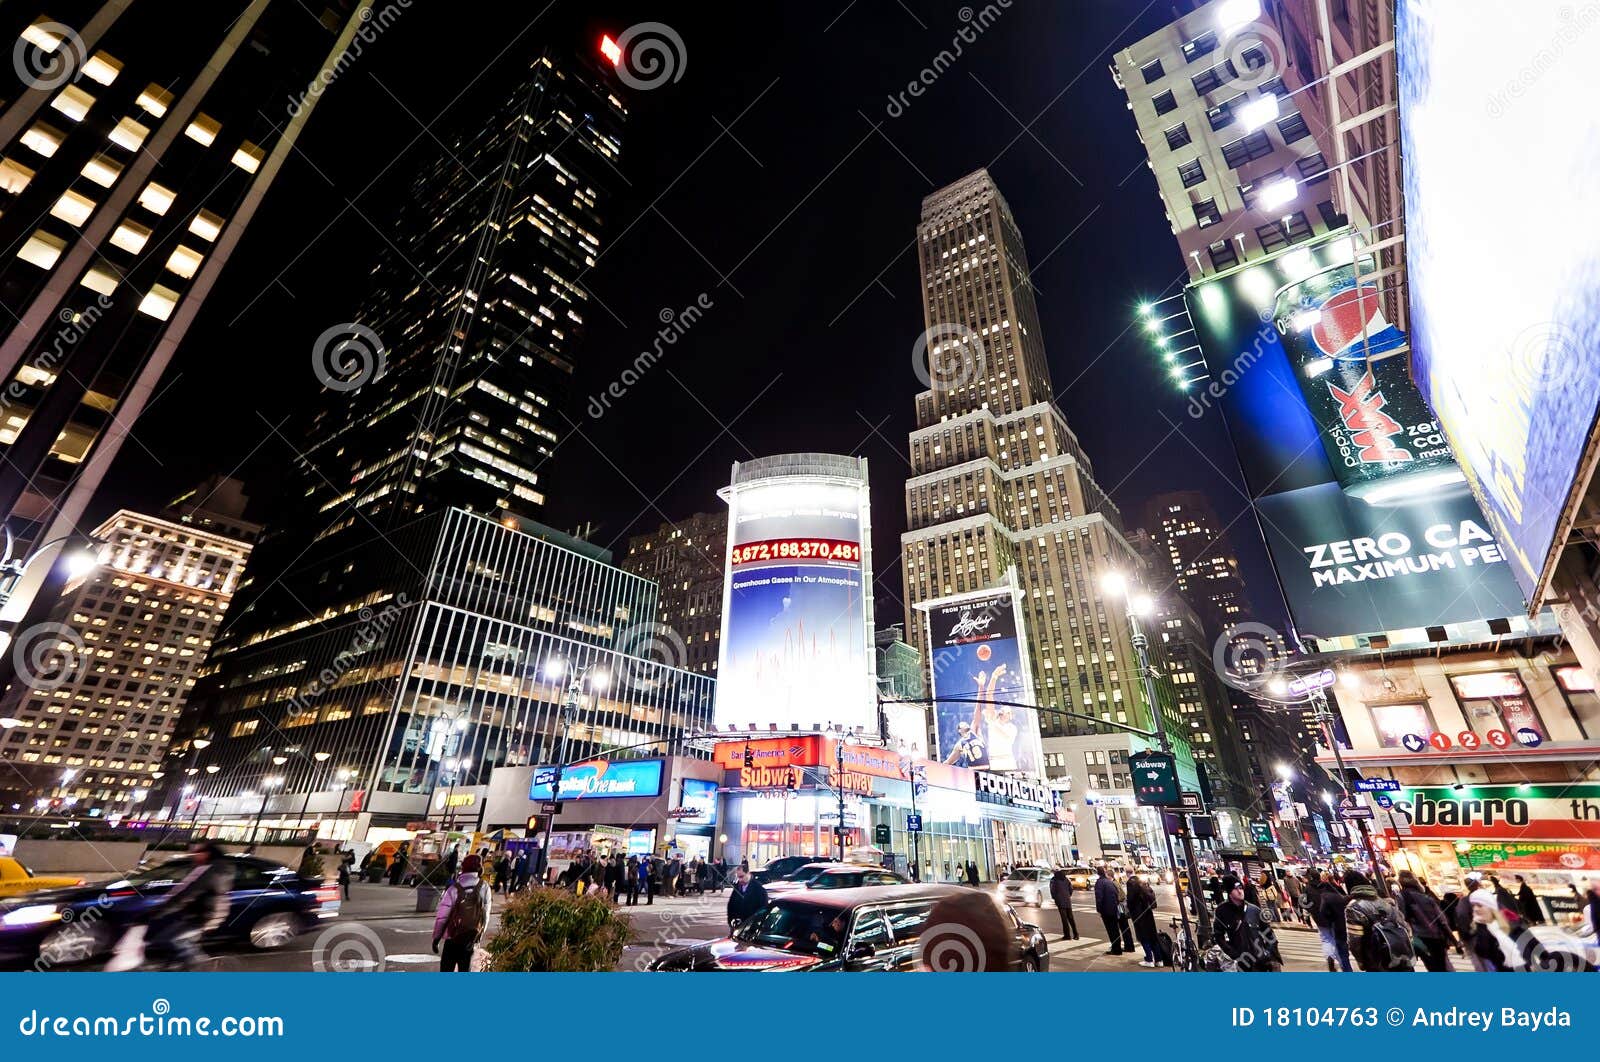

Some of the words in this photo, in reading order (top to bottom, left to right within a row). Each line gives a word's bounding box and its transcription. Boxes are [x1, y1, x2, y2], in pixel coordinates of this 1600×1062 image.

[1329, 424, 1358, 468] pepsi
[1304, 532, 1411, 568] ZERO
[1424, 520, 1494, 548] CA
[1312, 551, 1456, 587] MAXIMUM
[733, 579, 771, 589] Greenhouse
[818, 576, 859, 586] Atmosphere
[942, 605, 959, 614] FROM
[973, 601, 988, 609] LENS
[1463, 733, 1474, 747] 2
[1491, 732, 1506, 746] 3
[1136, 761, 1167, 769] Subway
[1394, 793, 1529, 826] sbarro
[1570, 799, 1600, 820] th
